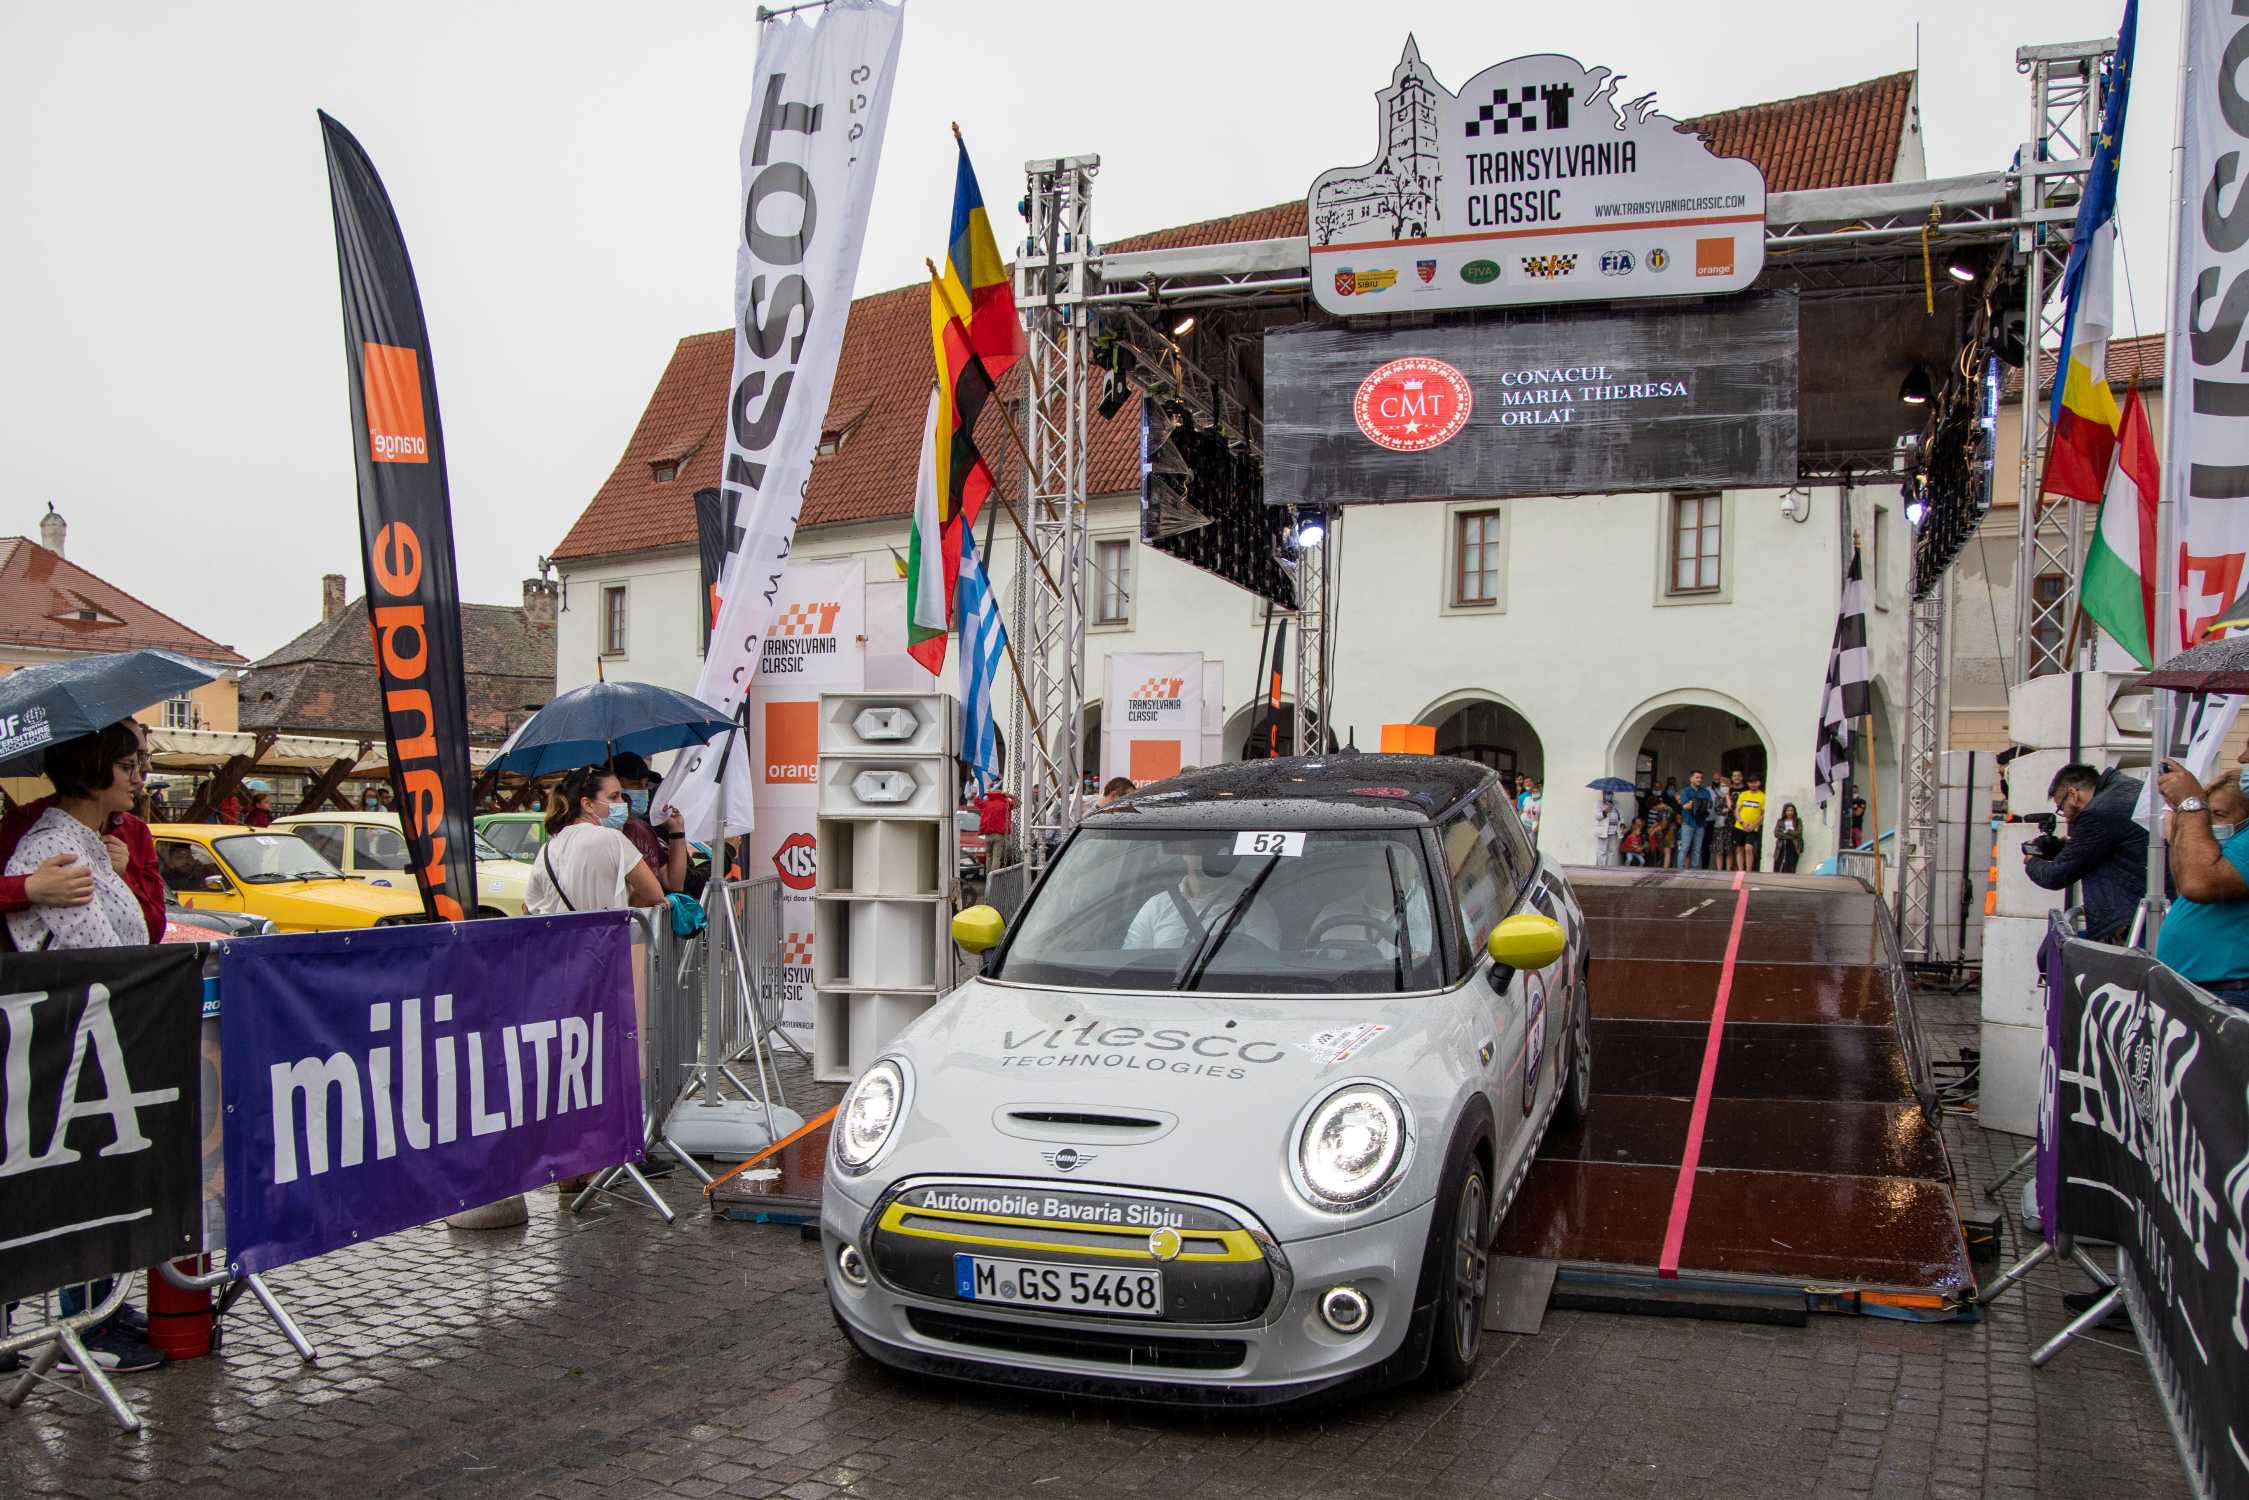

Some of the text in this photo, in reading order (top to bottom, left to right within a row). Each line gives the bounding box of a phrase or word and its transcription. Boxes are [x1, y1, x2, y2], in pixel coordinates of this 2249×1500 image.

[1466, 141, 1636, 186] TRANSYLVANIA
[1468, 189, 1561, 226] CLASSIC
[1595, 195, 1745, 217] WWW.TRANSYLVANIACLASSIC.COM
[1468, 267, 1493, 278] FIVA
[1697, 264, 1731, 275] orange
[1357, 280, 1378, 289] SIBIU
[1502, 367, 1612, 386] CONACUL
[1502, 382, 1688, 407] MARIA THERESA
[1380, 391, 1445, 419] CMT
[1501, 408, 1575, 426] ORLAT
[762, 657, 804, 673] CLASSIC
[1128, 699, 1181, 710] TRANSYLVANIA
[1128, 711, 1158, 722] CLASSIC
[768, 763, 818, 782] orang
[1253, 834, 1286, 853] 52
[1001, 1054, 1247, 1080] TECHNOLOGIES
[1055, 1154, 1077, 1163] MINI
[922, 1190, 1184, 1227] Automobile Bavaria Sibiu
[975, 1262, 996, 1296] M
[1018, 1267, 1061, 1301] GS
[1071, 1272, 1157, 1310] 5468
